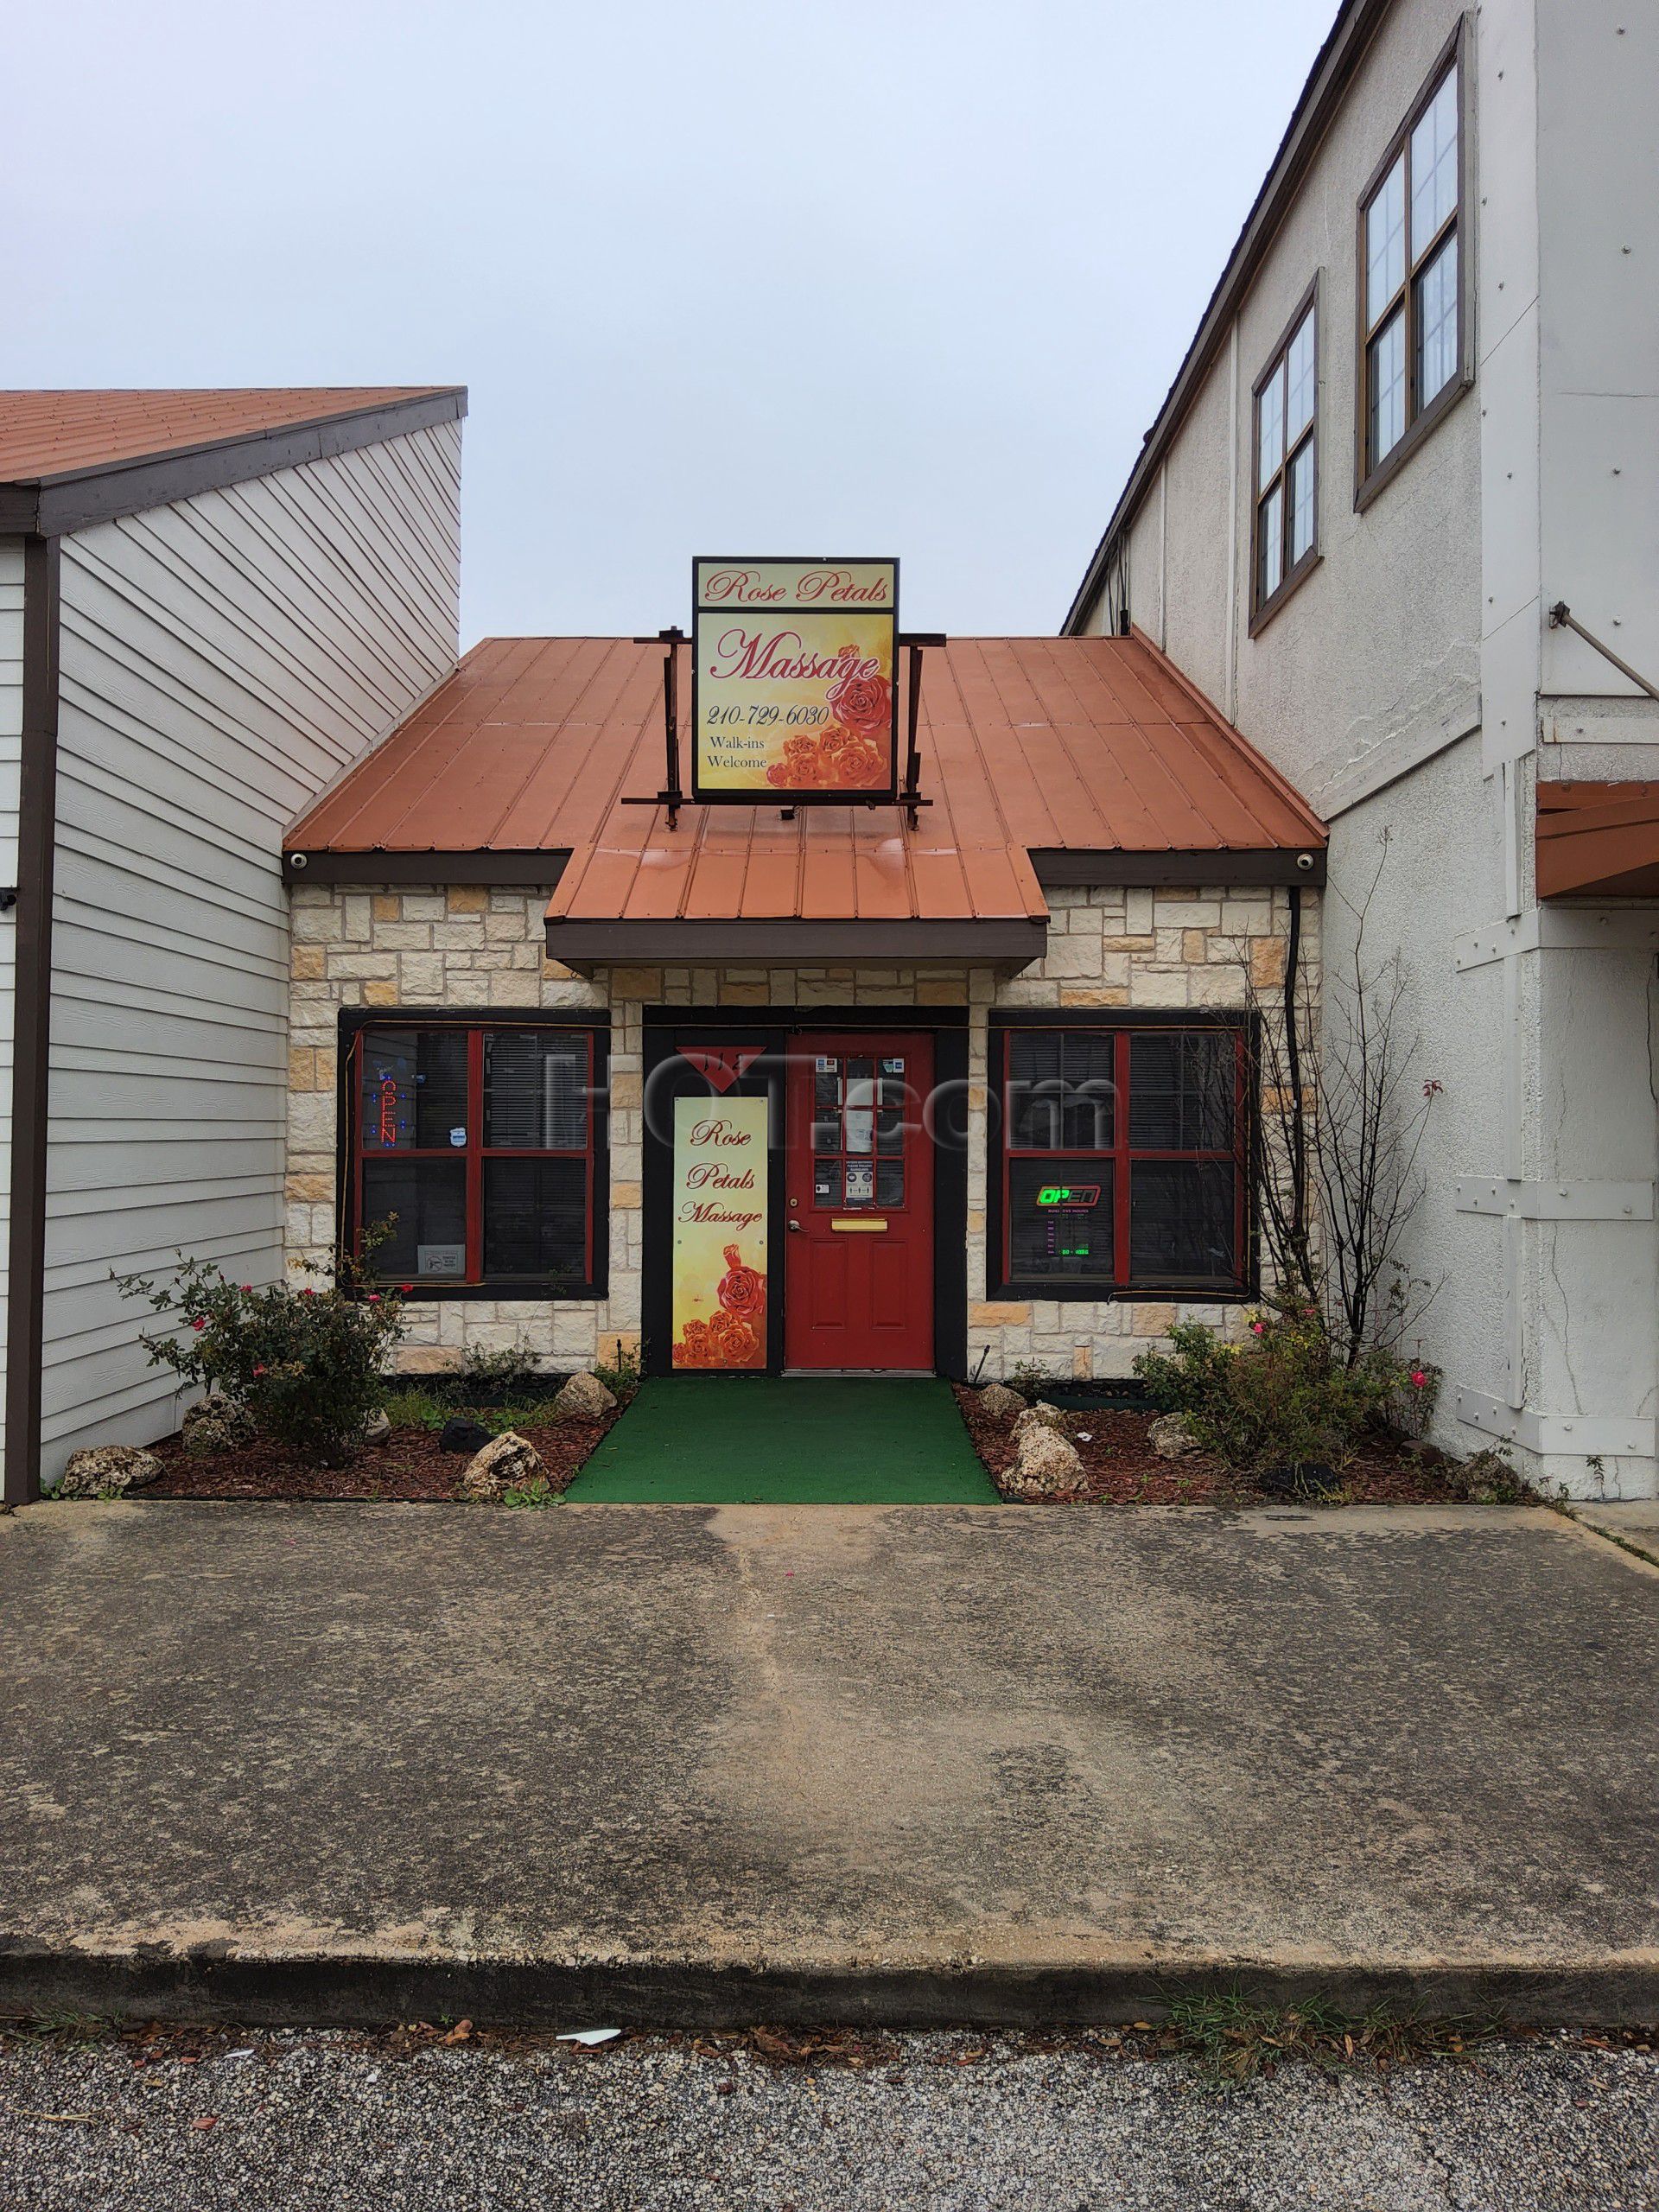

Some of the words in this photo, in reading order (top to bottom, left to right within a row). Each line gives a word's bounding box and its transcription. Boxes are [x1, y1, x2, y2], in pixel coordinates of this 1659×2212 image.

[705, 570, 787, 602] Rose
[796, 570, 888, 602] Petals
[709, 629, 880, 700] Massage
[707, 705, 830, 726] 210-729-6030
[709, 736, 765, 749] Walk-ins
[707, 755, 767, 768] Welcome
[381, 1080, 397, 1143] OPEN
[690, 1120, 752, 1147] Rose
[686, 1163, 755, 1190] Petals
[1039, 1189, 1096, 1204] OPEN
[678, 1201, 763, 1231] Massage
